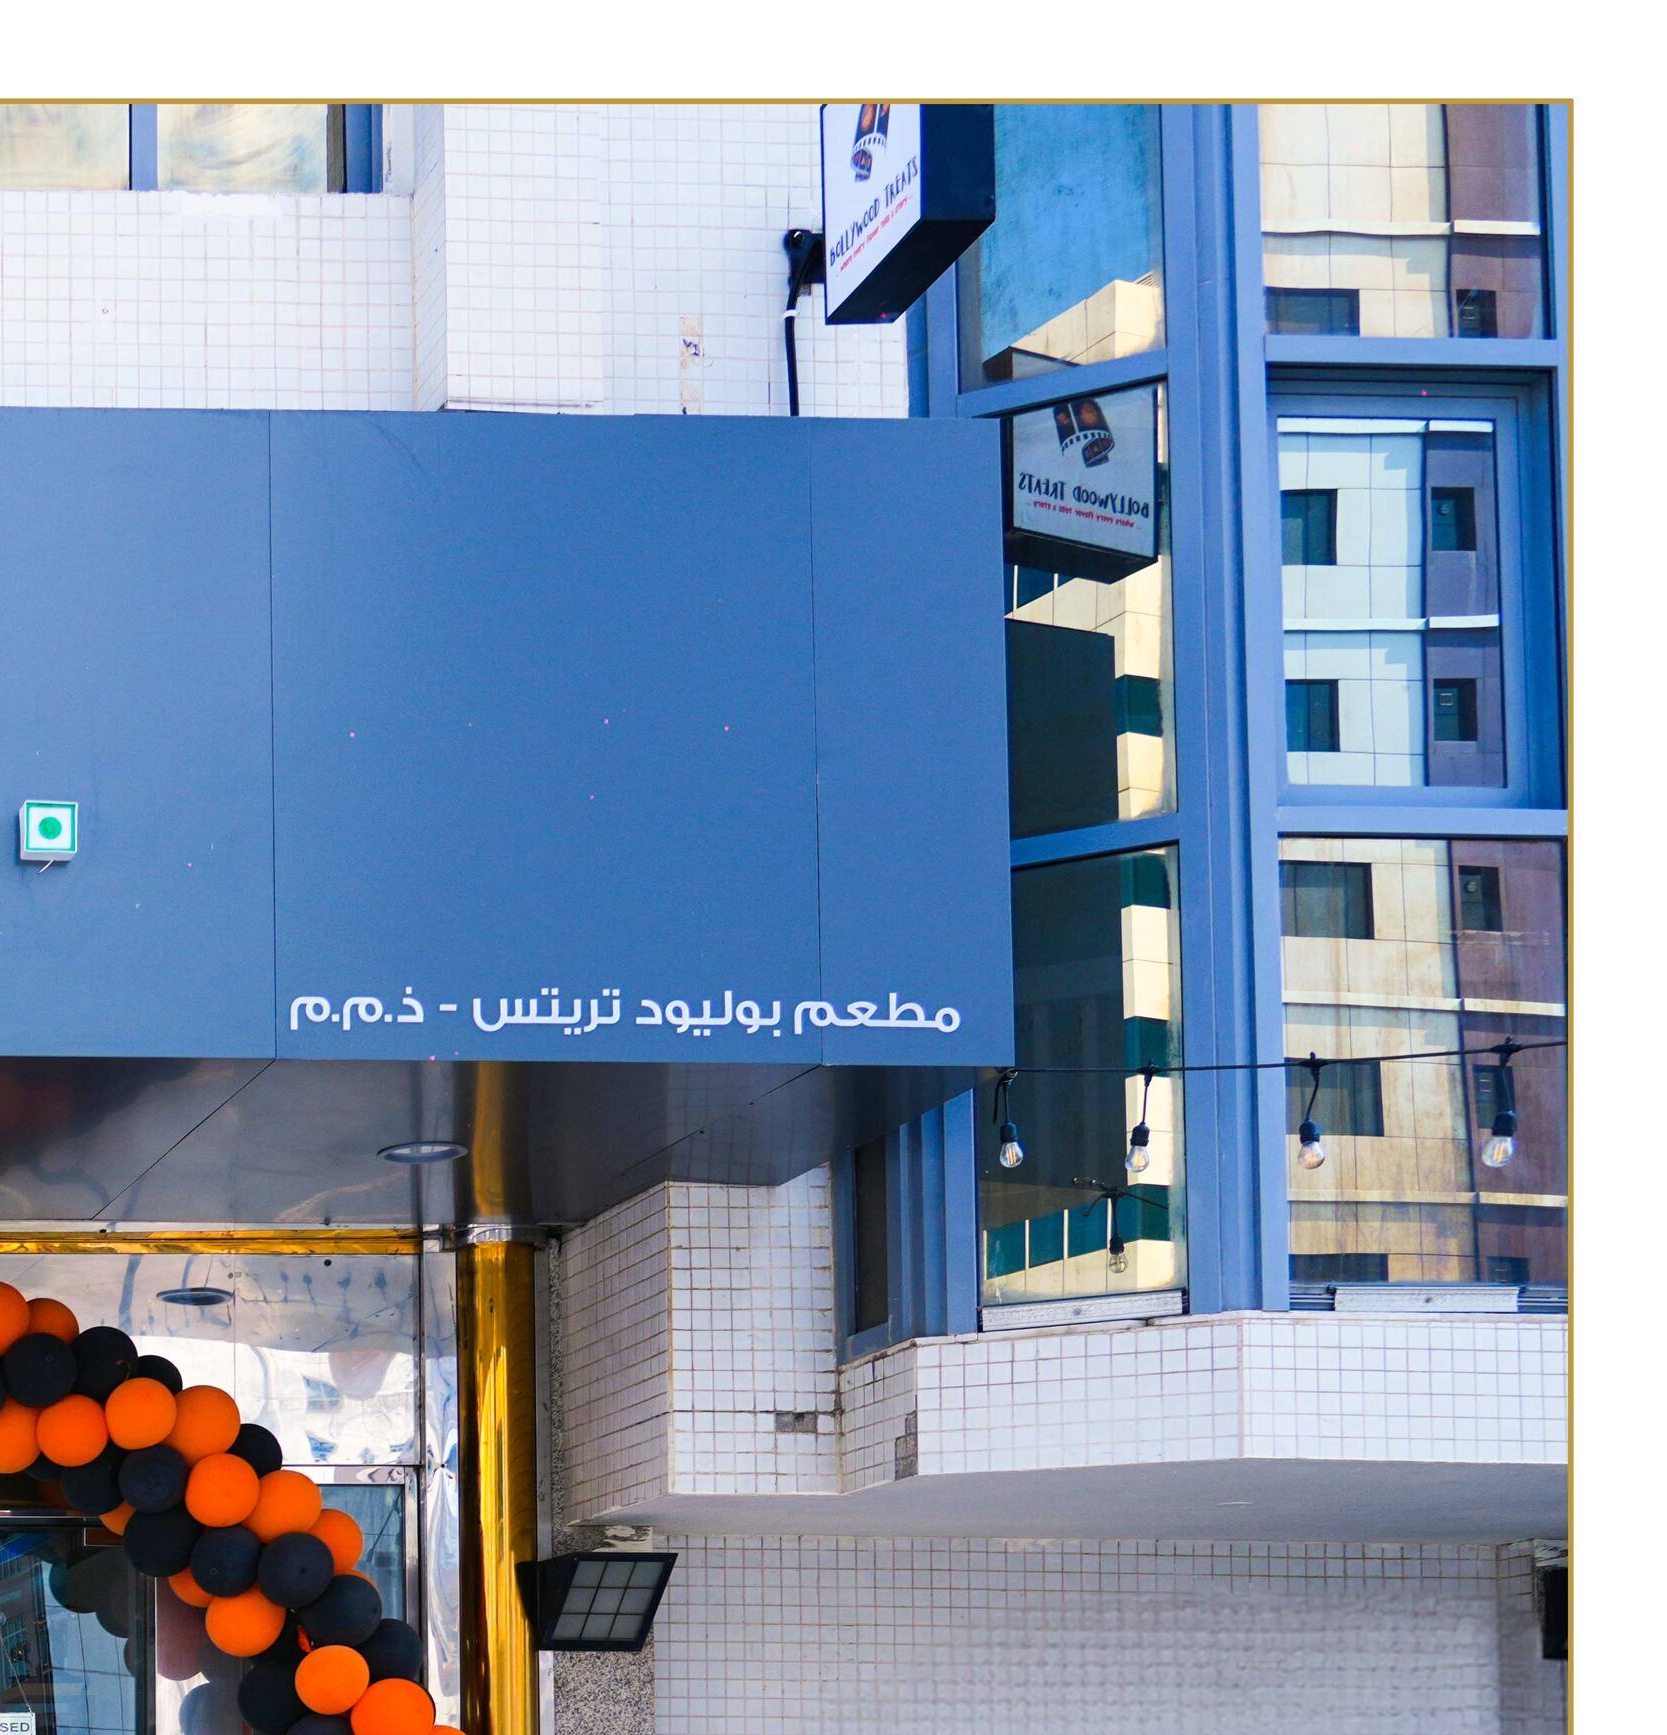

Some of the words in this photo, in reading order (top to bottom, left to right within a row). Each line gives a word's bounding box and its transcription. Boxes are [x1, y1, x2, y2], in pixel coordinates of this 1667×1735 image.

[830, 198, 880, 267] BOLLYWOOD
[884, 155, 918, 209] TREATS
[290, 986, 424, 1031] ذ.م.م
[473, 987, 620, 1035] تريتس
[635, 990, 781, 1036] بوليود
[794, 992, 960, 1035] مطعم
